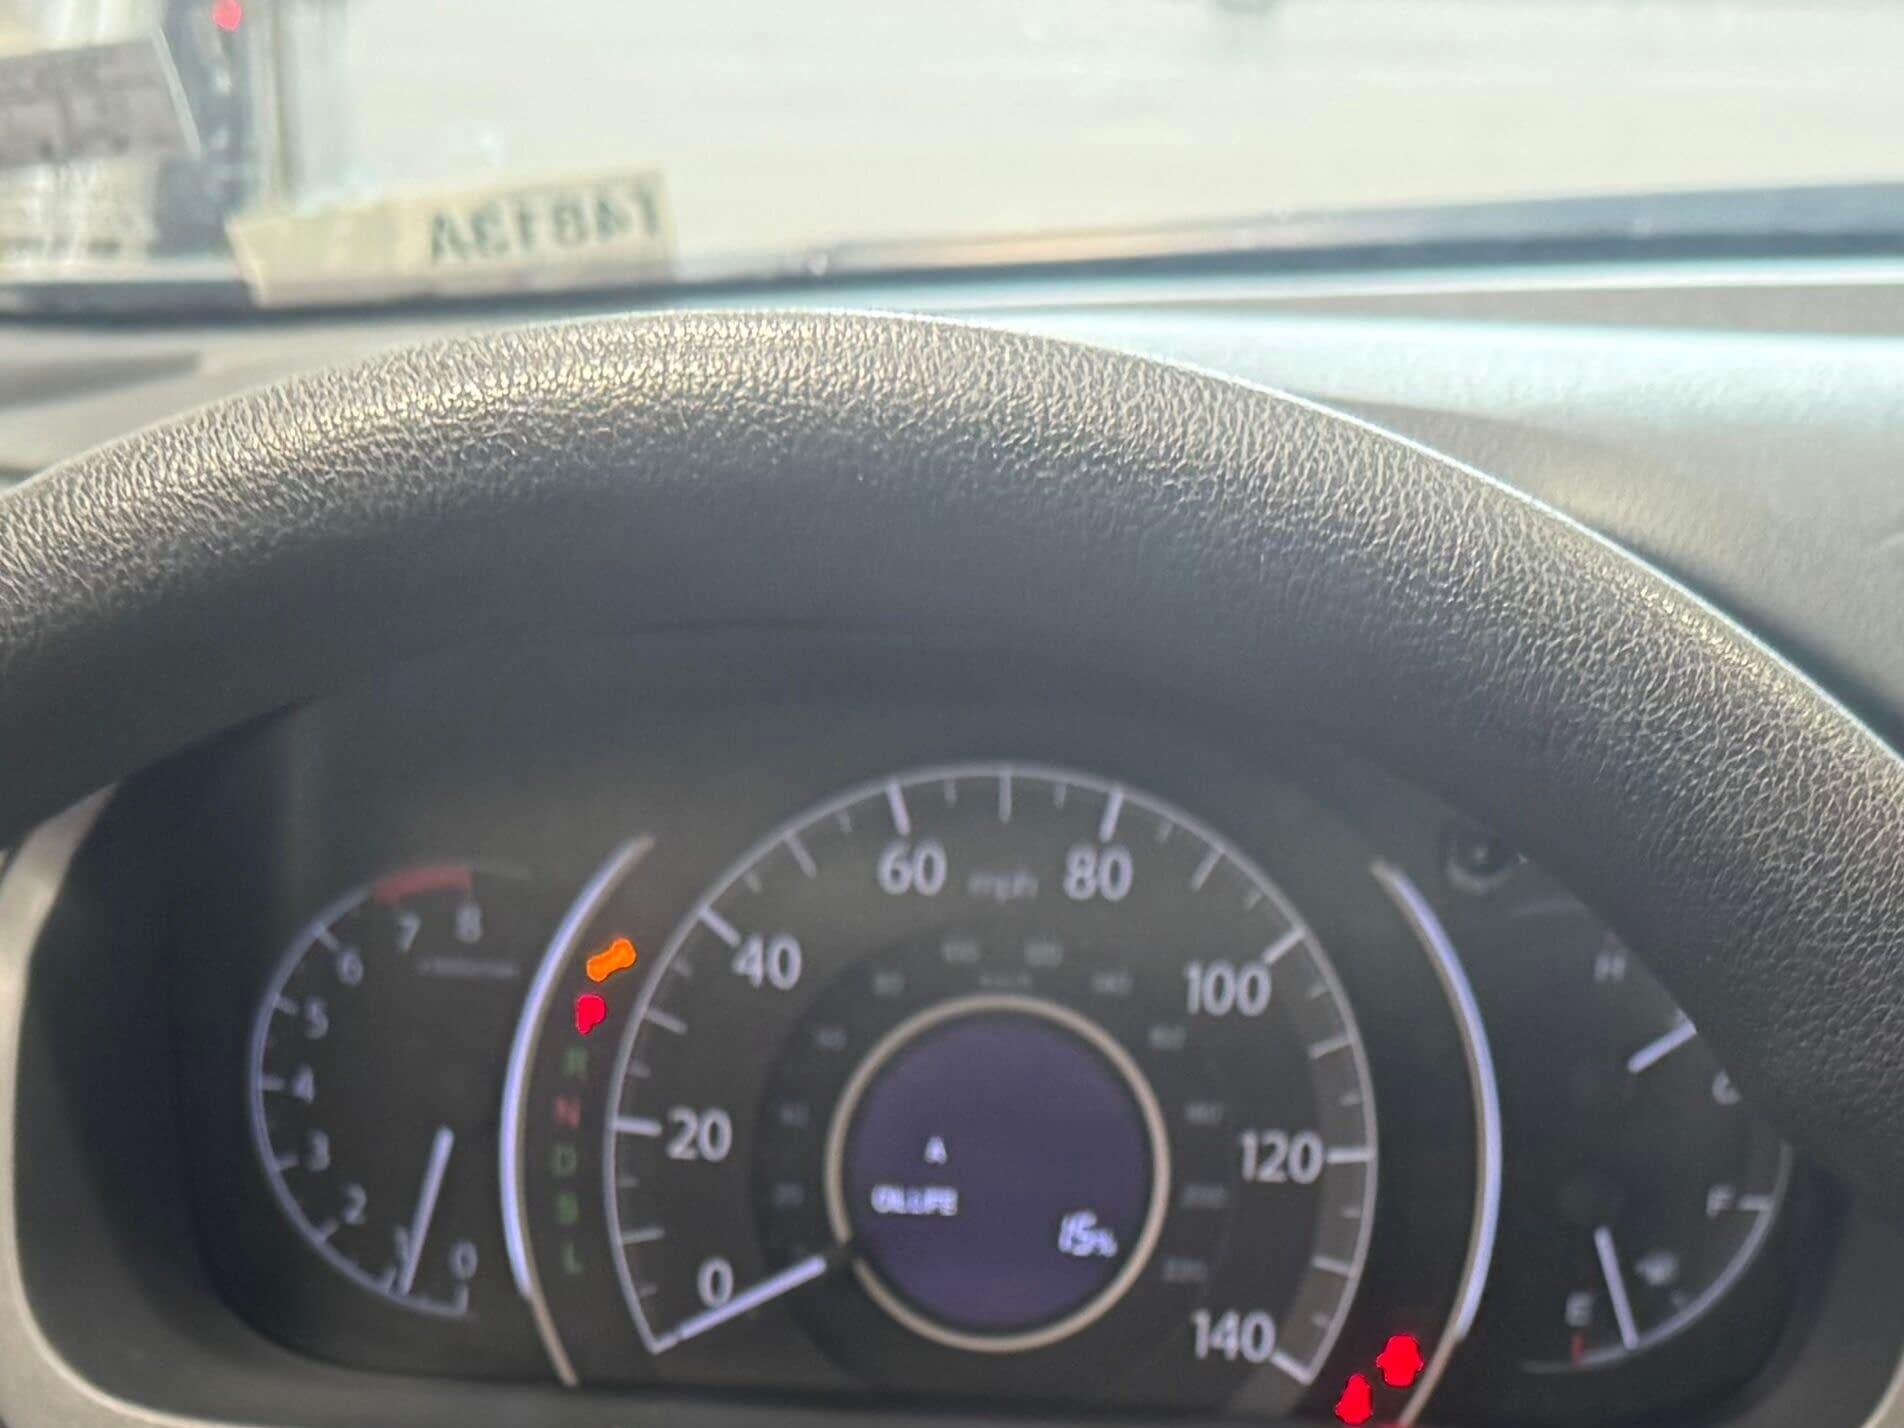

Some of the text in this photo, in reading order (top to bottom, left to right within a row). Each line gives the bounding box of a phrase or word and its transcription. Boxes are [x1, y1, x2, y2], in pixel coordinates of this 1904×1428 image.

[877, 839, 947, 896] 60
[969, 867, 1039, 902] mph
[1063, 847, 1133, 902] 80
[399, 912, 420, 951] 7
[456, 903, 482, 943] 8
[338, 948, 363, 986] 6
[731, 933, 802, 990] 40
[1185, 960, 1271, 1017] 100
[304, 1000, 328, 1039] 5
[293, 1065, 315, 1102] 4
[308, 1131, 330, 1171] 3
[666, 1107, 732, 1162] 20
[1239, 1129, 1323, 1184] 120
[343, 1183, 367, 1225] 2
[450, 1242, 478, 1279] 0
[698, 1259, 733, 1308] 0
[1192, 1309, 1276, 1364] 140
